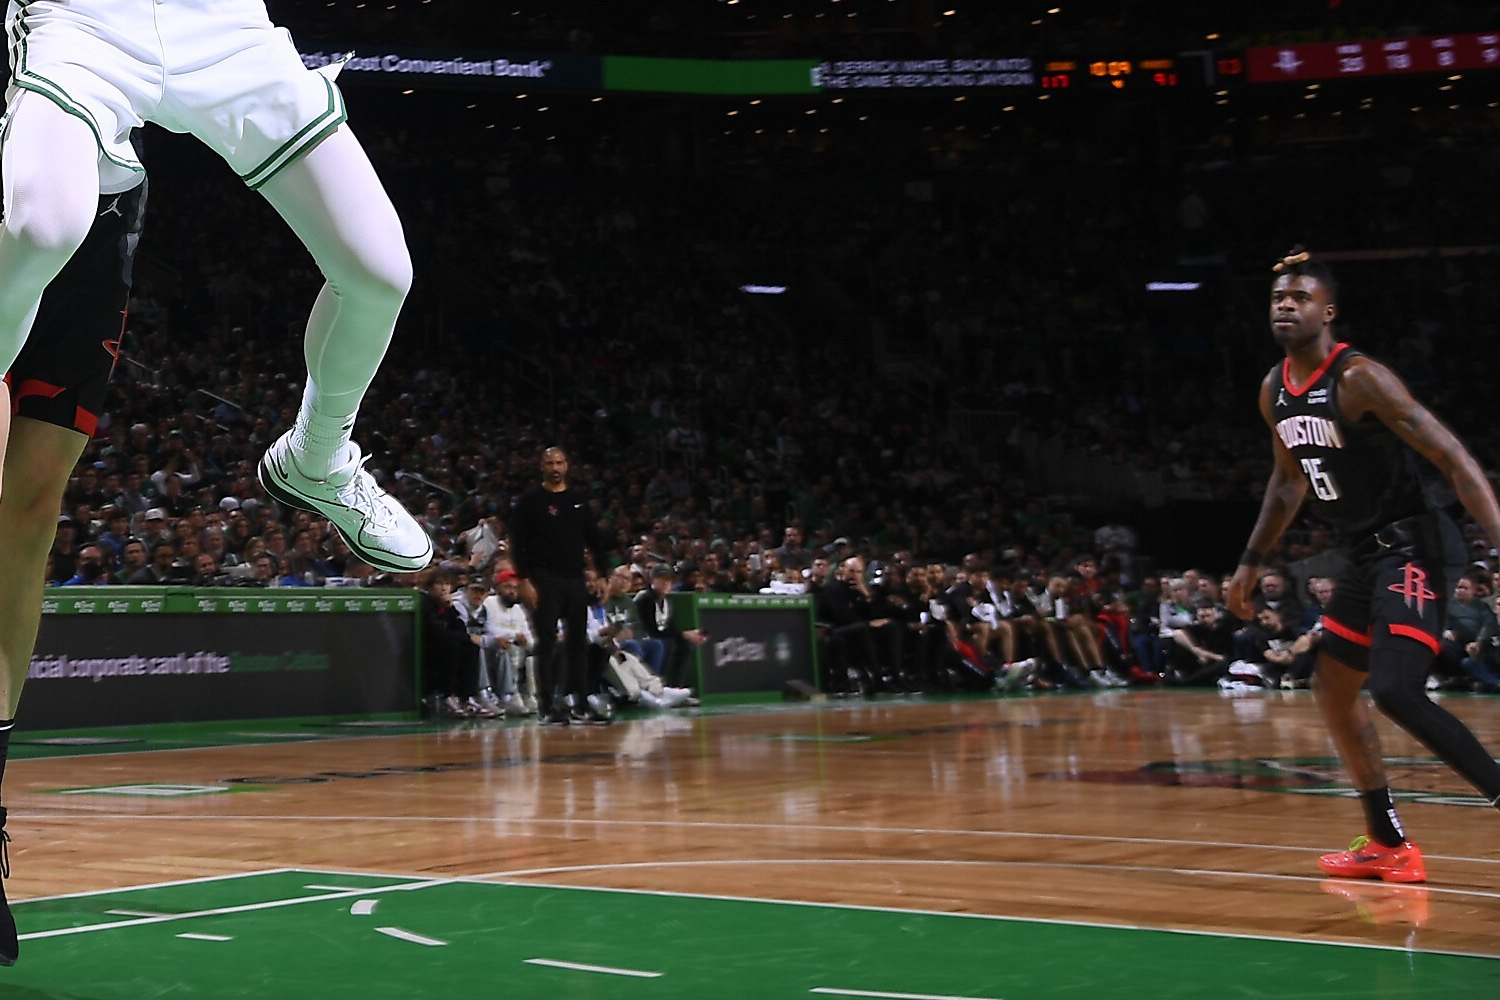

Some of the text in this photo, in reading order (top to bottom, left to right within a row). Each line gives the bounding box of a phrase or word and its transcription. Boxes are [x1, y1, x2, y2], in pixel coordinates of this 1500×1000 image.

[381, 53, 494, 78] Convenient
[1275, 414, 1344, 450] OUSTON
[68, 654, 148, 682] corporate
[149, 652, 186, 675] card
[203, 651, 231, 674] the
